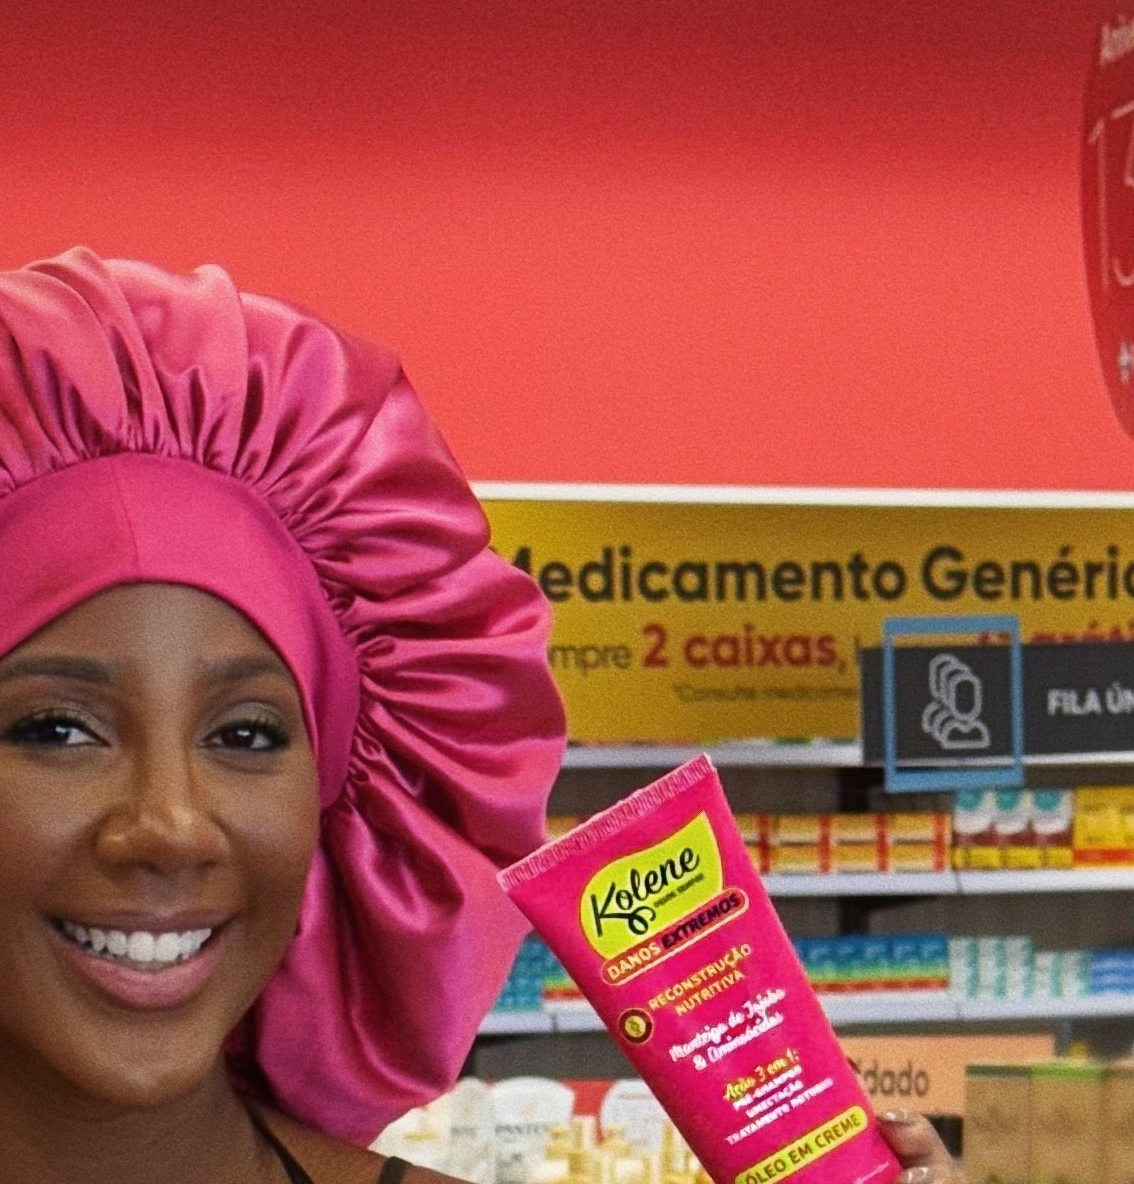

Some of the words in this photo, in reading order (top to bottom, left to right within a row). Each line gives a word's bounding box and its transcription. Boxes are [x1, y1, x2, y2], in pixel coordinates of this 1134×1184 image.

[641, 623, 669, 670] 2
[682, 622, 847, 676] caixas,
[1047, 688, 1102, 716] FILA
[590, 847, 700, 938] Kolene
[607, 941, 663, 981] DANOS
[661, 892, 741, 950] EXTREMOS
[648, 943, 752, 1011] RECONSTRUÇÃO
[674, 967, 747, 1017] NUTRITIVA
[857, 1057, 929, 1098] dado
[788, 1141, 815, 1165] EM
[814, 1112, 863, 1151] CREME
